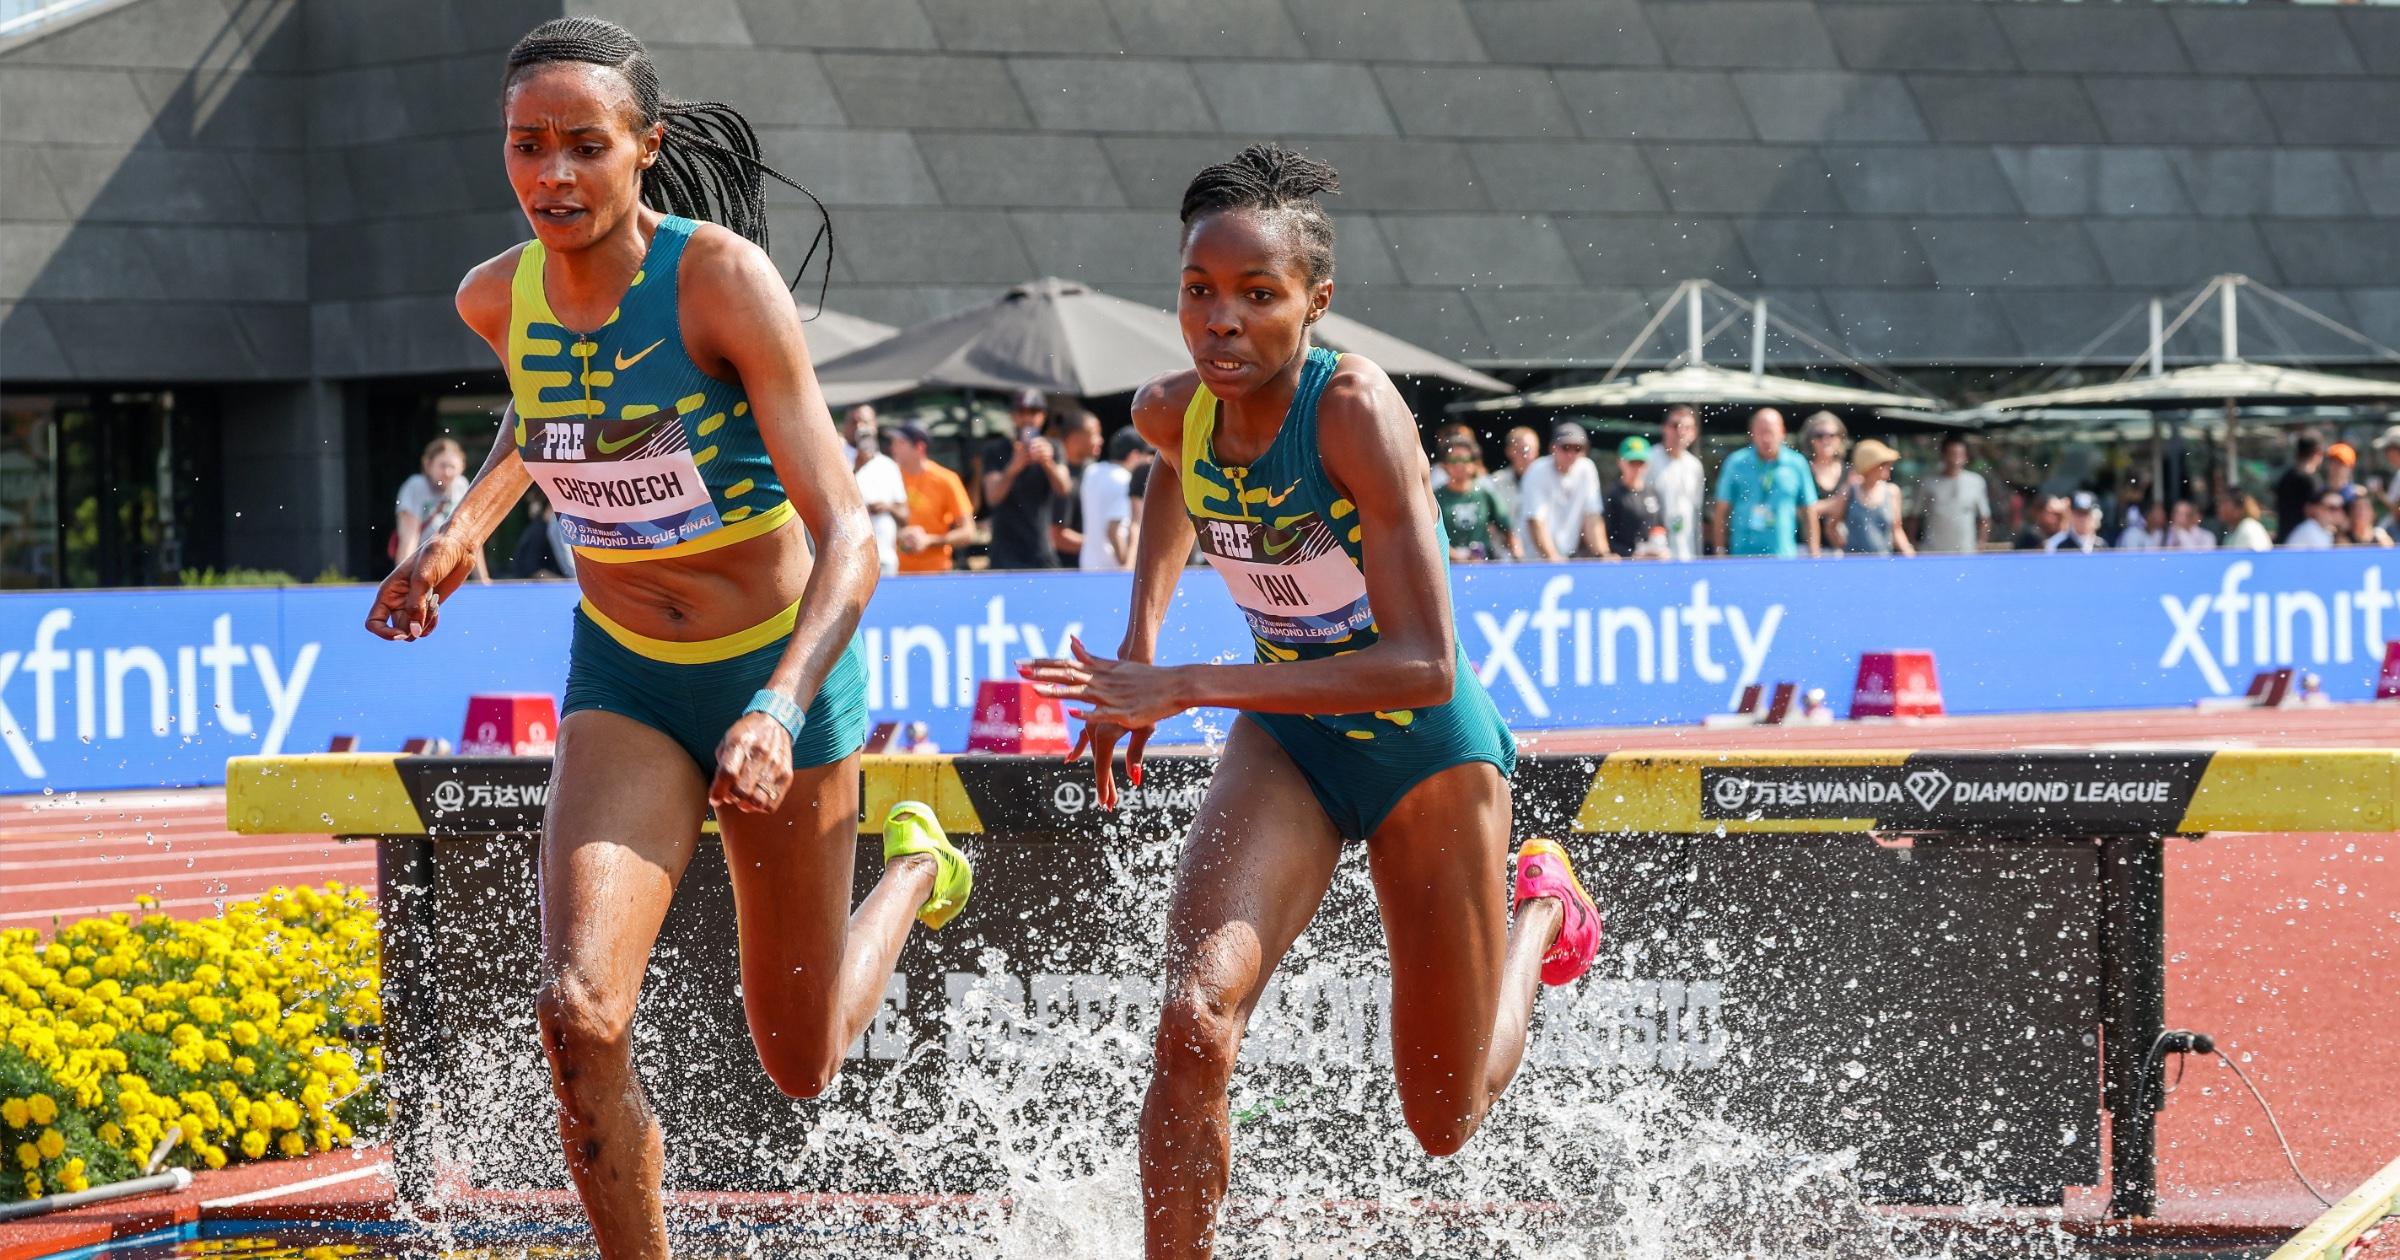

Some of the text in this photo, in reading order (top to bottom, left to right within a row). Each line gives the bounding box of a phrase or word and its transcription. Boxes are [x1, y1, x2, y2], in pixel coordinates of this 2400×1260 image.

[543, 423, 587, 461] PRE
[552, 471, 685, 508] CHEPKOECH
[580, 516, 715, 547] DIAMOND LEAGUE FINAL
[1209, 520, 1253, 559] PRE
[1247, 573, 1309, 607] YAVI
[1261, 625, 1303, 637] DIAMOND
[1306, 621, 1348, 637] LEAGUE
[2160, 560, 2400, 694] xfinit
[1473, 574, 1786, 719] xfinity
[1953, 781, 2069, 803] DIAMOND
[2073, 781, 2171, 803] LEAGUE
